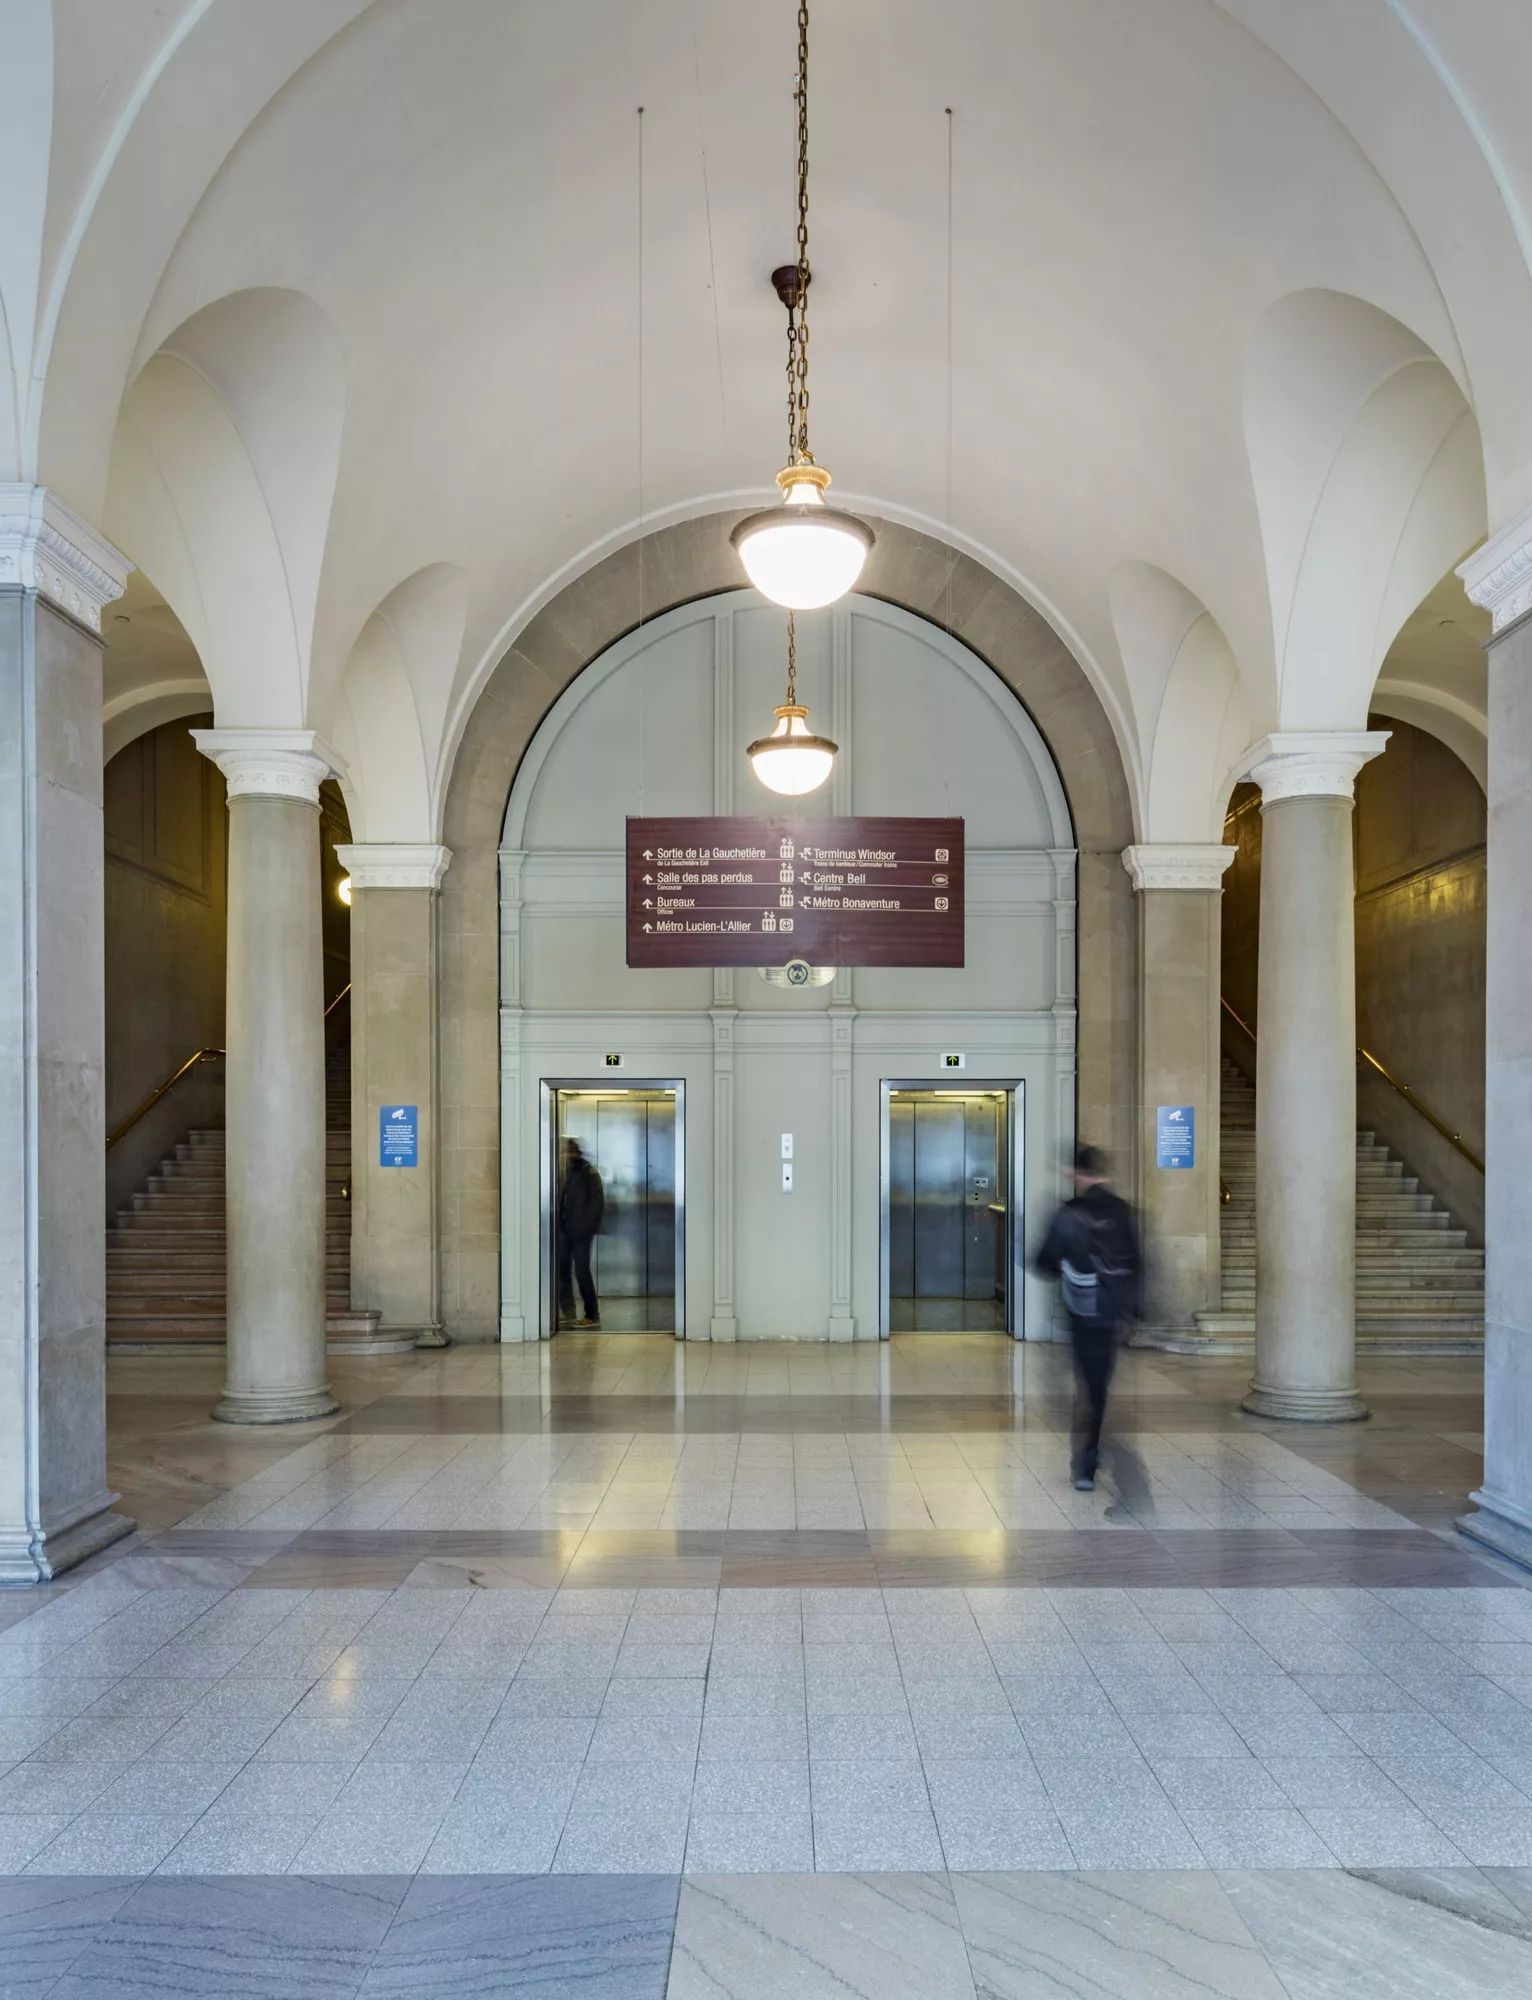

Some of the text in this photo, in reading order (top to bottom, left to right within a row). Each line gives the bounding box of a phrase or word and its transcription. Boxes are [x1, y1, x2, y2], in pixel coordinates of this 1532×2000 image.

[657, 847, 766, 858] Sortie de La Gauchetière
[814, 848, 896, 860] Terminus Windsor
[657, 872, 753, 885] Salle des pas perdus
[813, 872, 866, 884] Centre Bell
[657, 896, 695, 907] Bureaux
[813, 896, 900, 909] Métro Bonaventure
[656, 920, 752, 932] Métro Lucien-L'Allier
